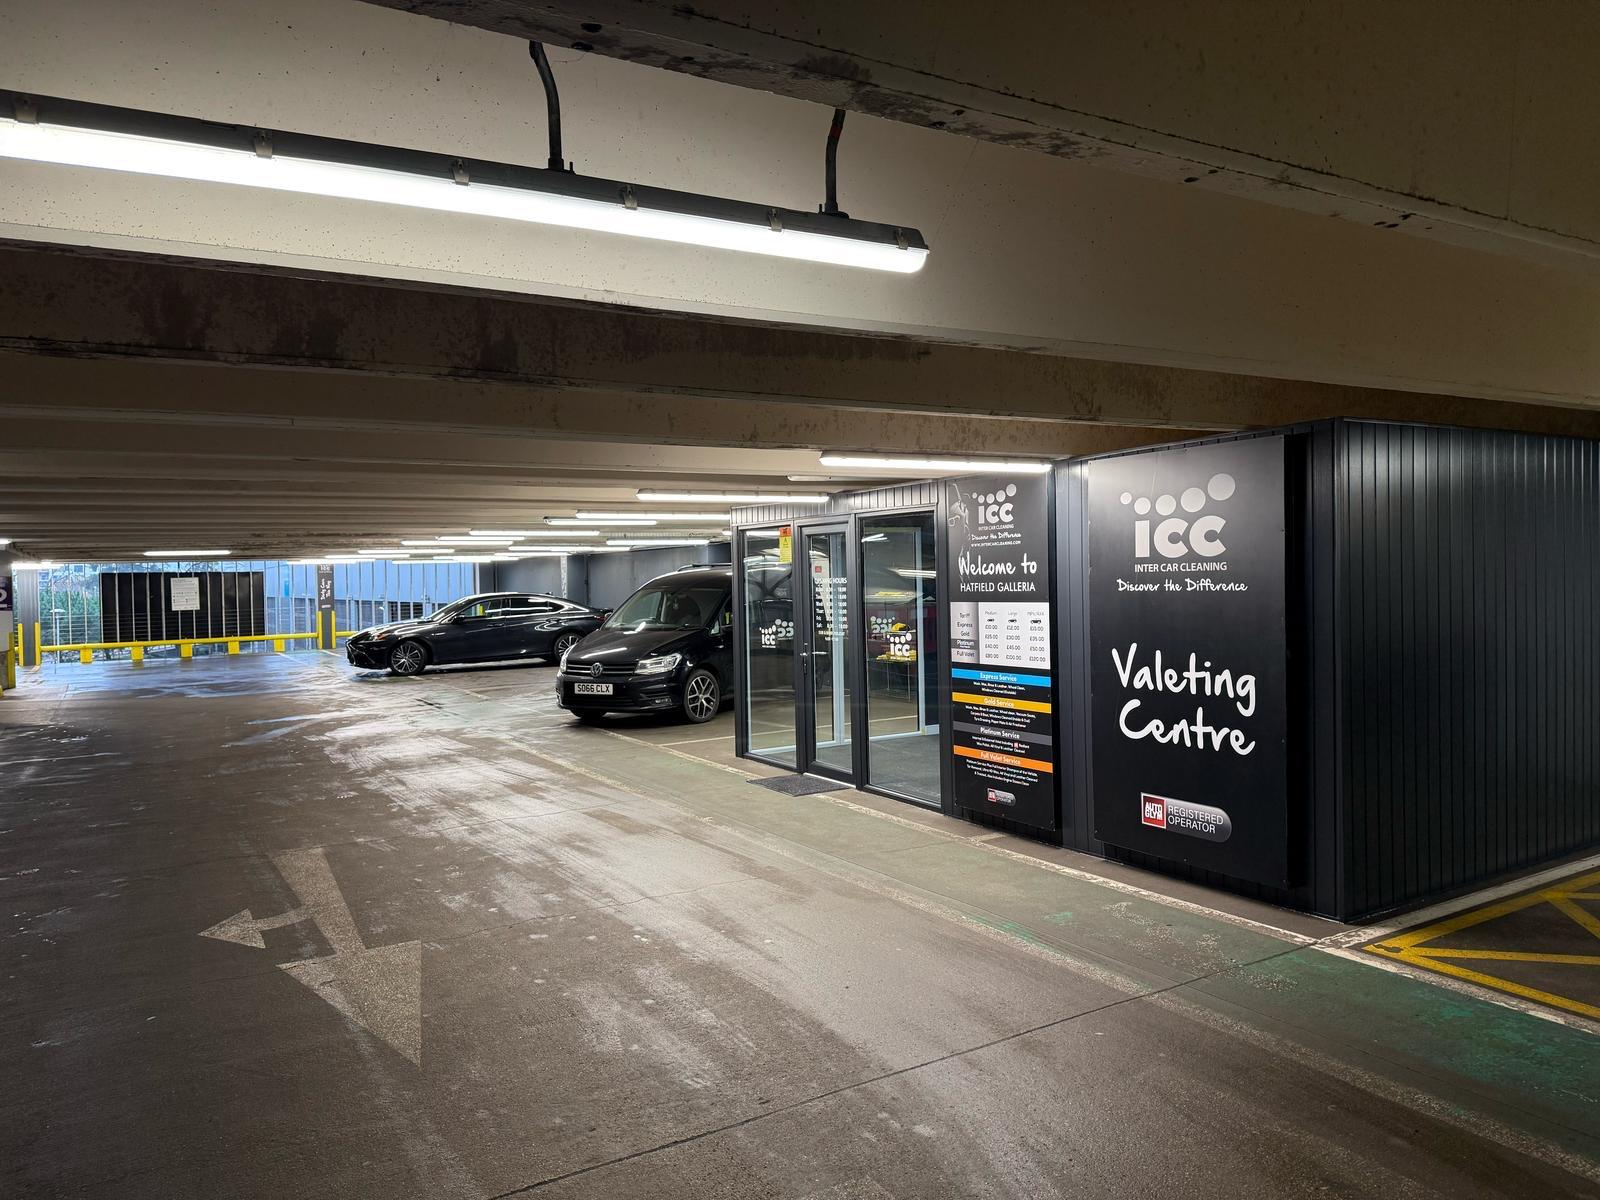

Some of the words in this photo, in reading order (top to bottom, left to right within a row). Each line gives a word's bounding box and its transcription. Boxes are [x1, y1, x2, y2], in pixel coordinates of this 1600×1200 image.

[959, 552, 1016, 575] Welcome
[1021, 553, 1037, 574] to
[1134, 564, 1159, 572] INTER
[1160, 563, 1179, 572] CAR
[1180, 562, 1228, 572] CLEANING
[960, 582, 994, 592] HATFIELD
[998, 582, 1036, 592] GALLERIA
[1116, 578, 1160, 591] Discover
[1164, 579, 1182, 591] the
[1185, 578, 1248, 591] Difference
[980, 672, 998, 680] Express
[1112, 642, 1256, 717] Valeting
[596, 685, 610, 693] CLX
[984, 697, 996, 705] Gold
[997, 699, 1014, 708] Service
[981, 727, 1001, 736] Platinum
[1002, 730, 1020, 739] Service
[1119, 699, 1256, 756] Centre
[981, 751, 989, 759] Full
[990, 753, 1002, 761] Valet
[1003, 756, 1020, 765] Service
[1145, 802, 1162, 812] AUTO
[1145, 810, 1162, 820] GLYM
[1168, 805, 1224, 825] REGISTERED
[1168, 816, 1216, 834] OPERATOR
